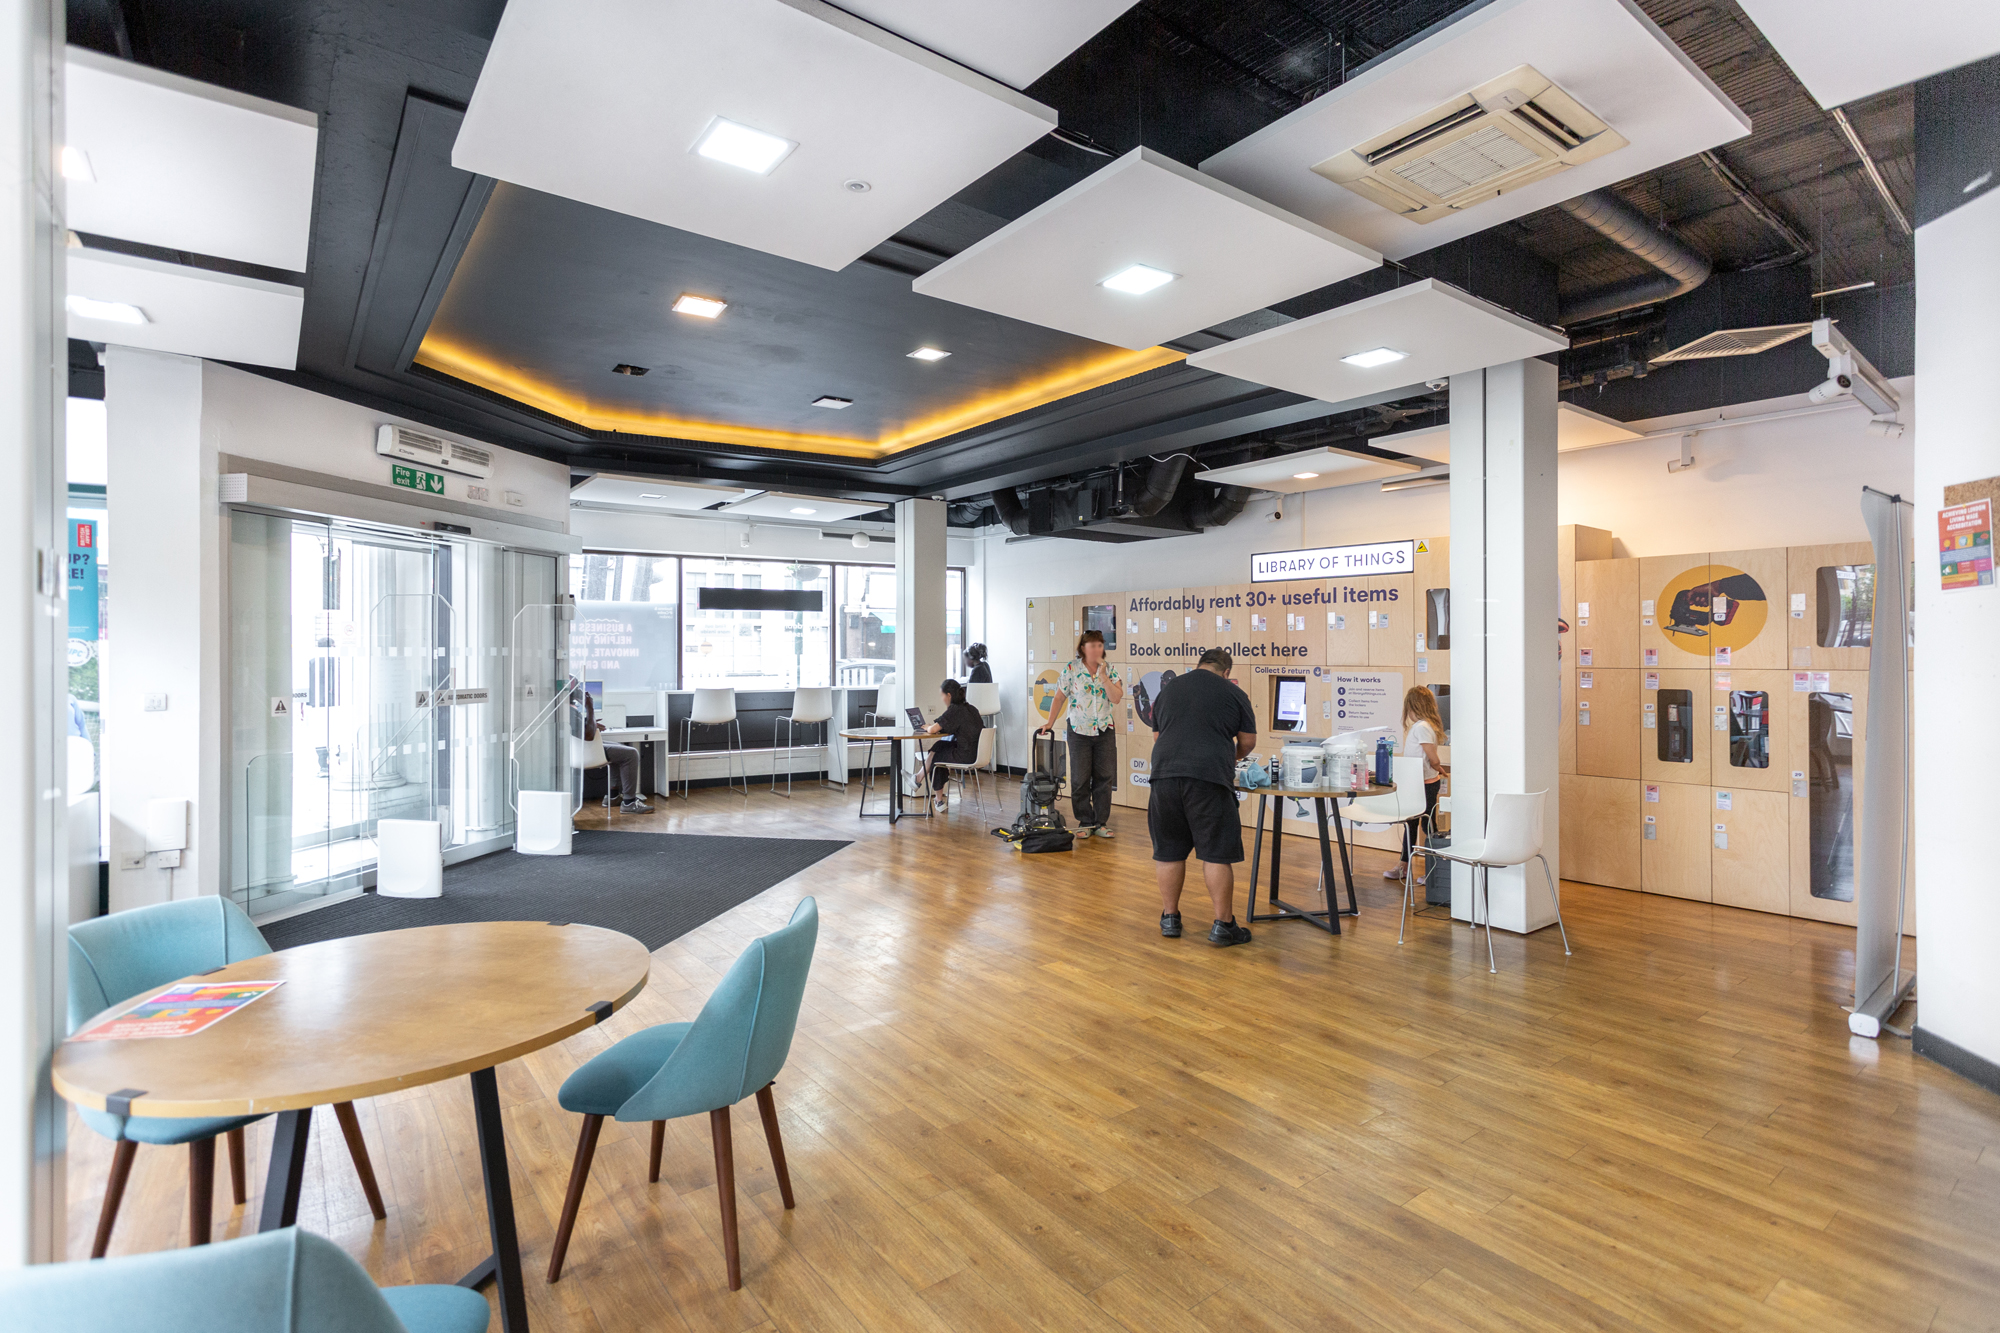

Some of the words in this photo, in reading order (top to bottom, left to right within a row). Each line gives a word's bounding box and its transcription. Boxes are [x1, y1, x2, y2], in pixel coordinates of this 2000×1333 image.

[396, 466, 410, 477] Fire
[396, 478, 410, 486] exit
[1258, 558, 1316, 574] LIBRARY
[1320, 556, 1339, 570] OF
[1344, 550, 1405, 568] THINGS
[68, 568, 84, 580] E!
[1130, 594, 1204, 613] Affordably
[1210, 594, 1242, 608] rent
[1246, 590, 1276, 607] 30+
[1282, 586, 1337, 606] useful
[1344, 586, 1399, 603] items
[1130, 643, 1160, 656] Book
[1216, 642, 1266, 656] ollect
[1271, 642, 1308, 656] here
